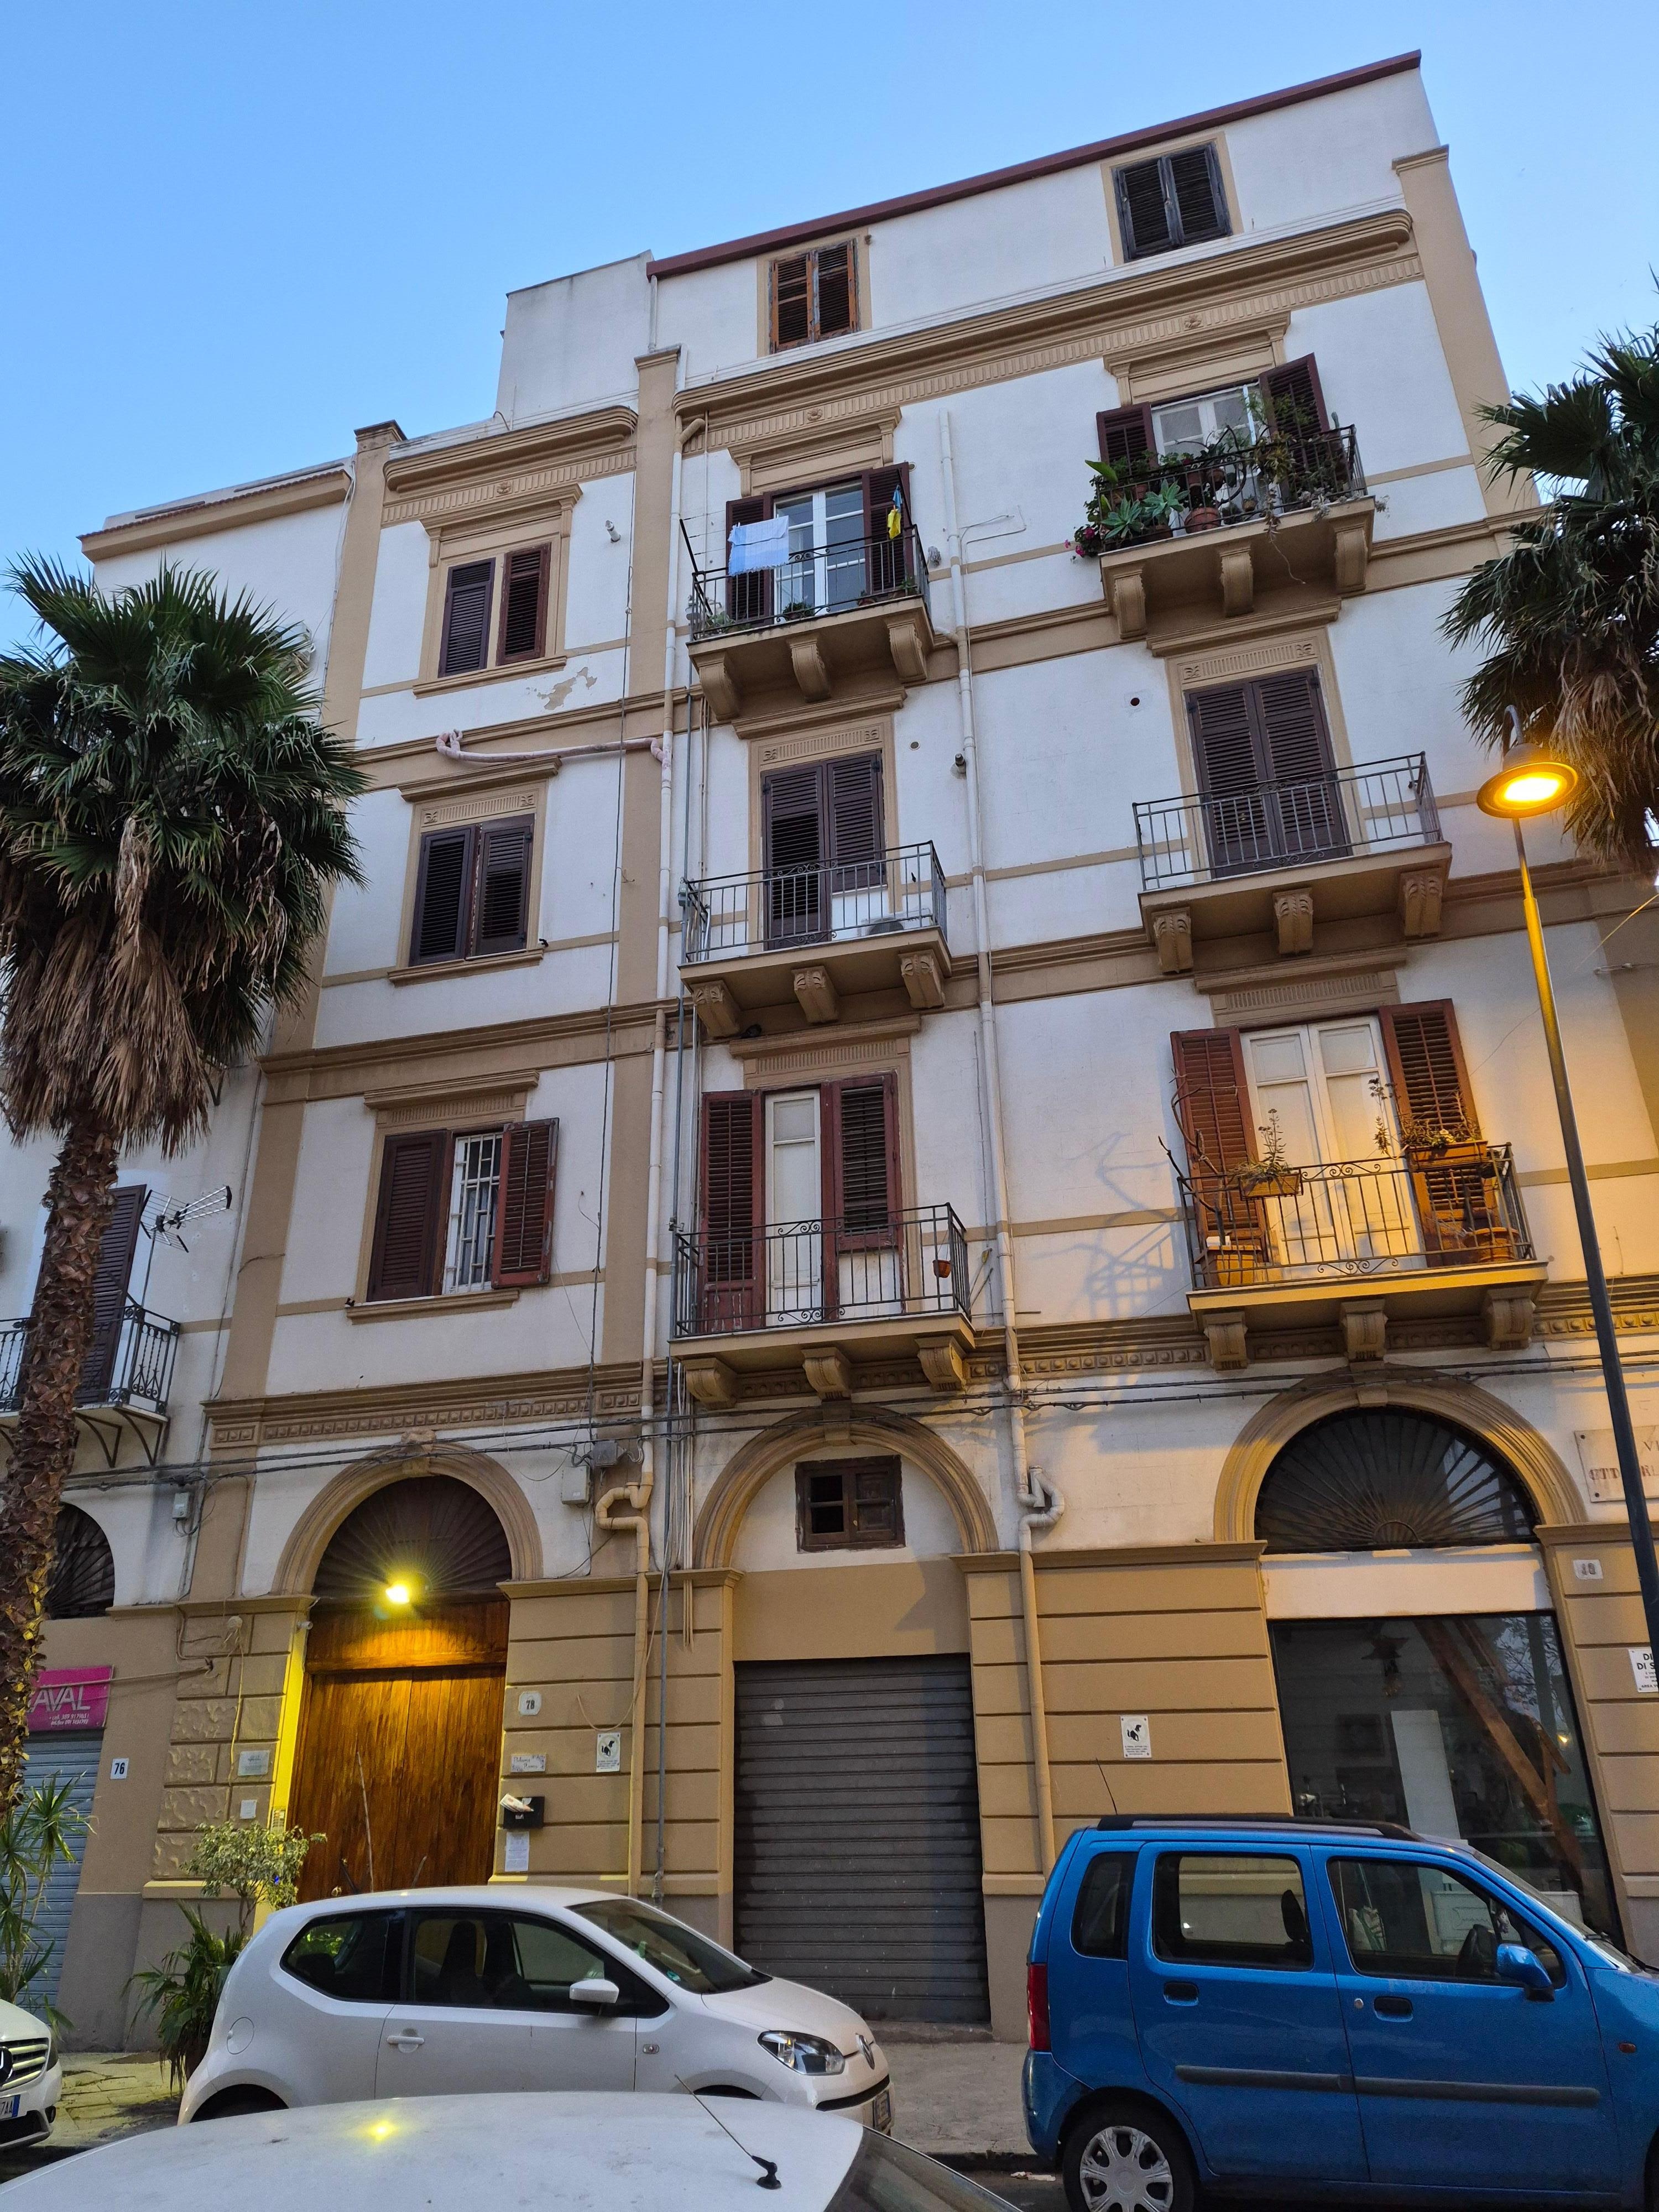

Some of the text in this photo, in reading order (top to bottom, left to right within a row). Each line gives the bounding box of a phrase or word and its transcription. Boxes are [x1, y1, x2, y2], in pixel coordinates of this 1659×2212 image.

[27, 1685, 91, 1713] AVAL
[526, 1699, 535, 1709] 78
[114, 1762, 125, 1775] 76
